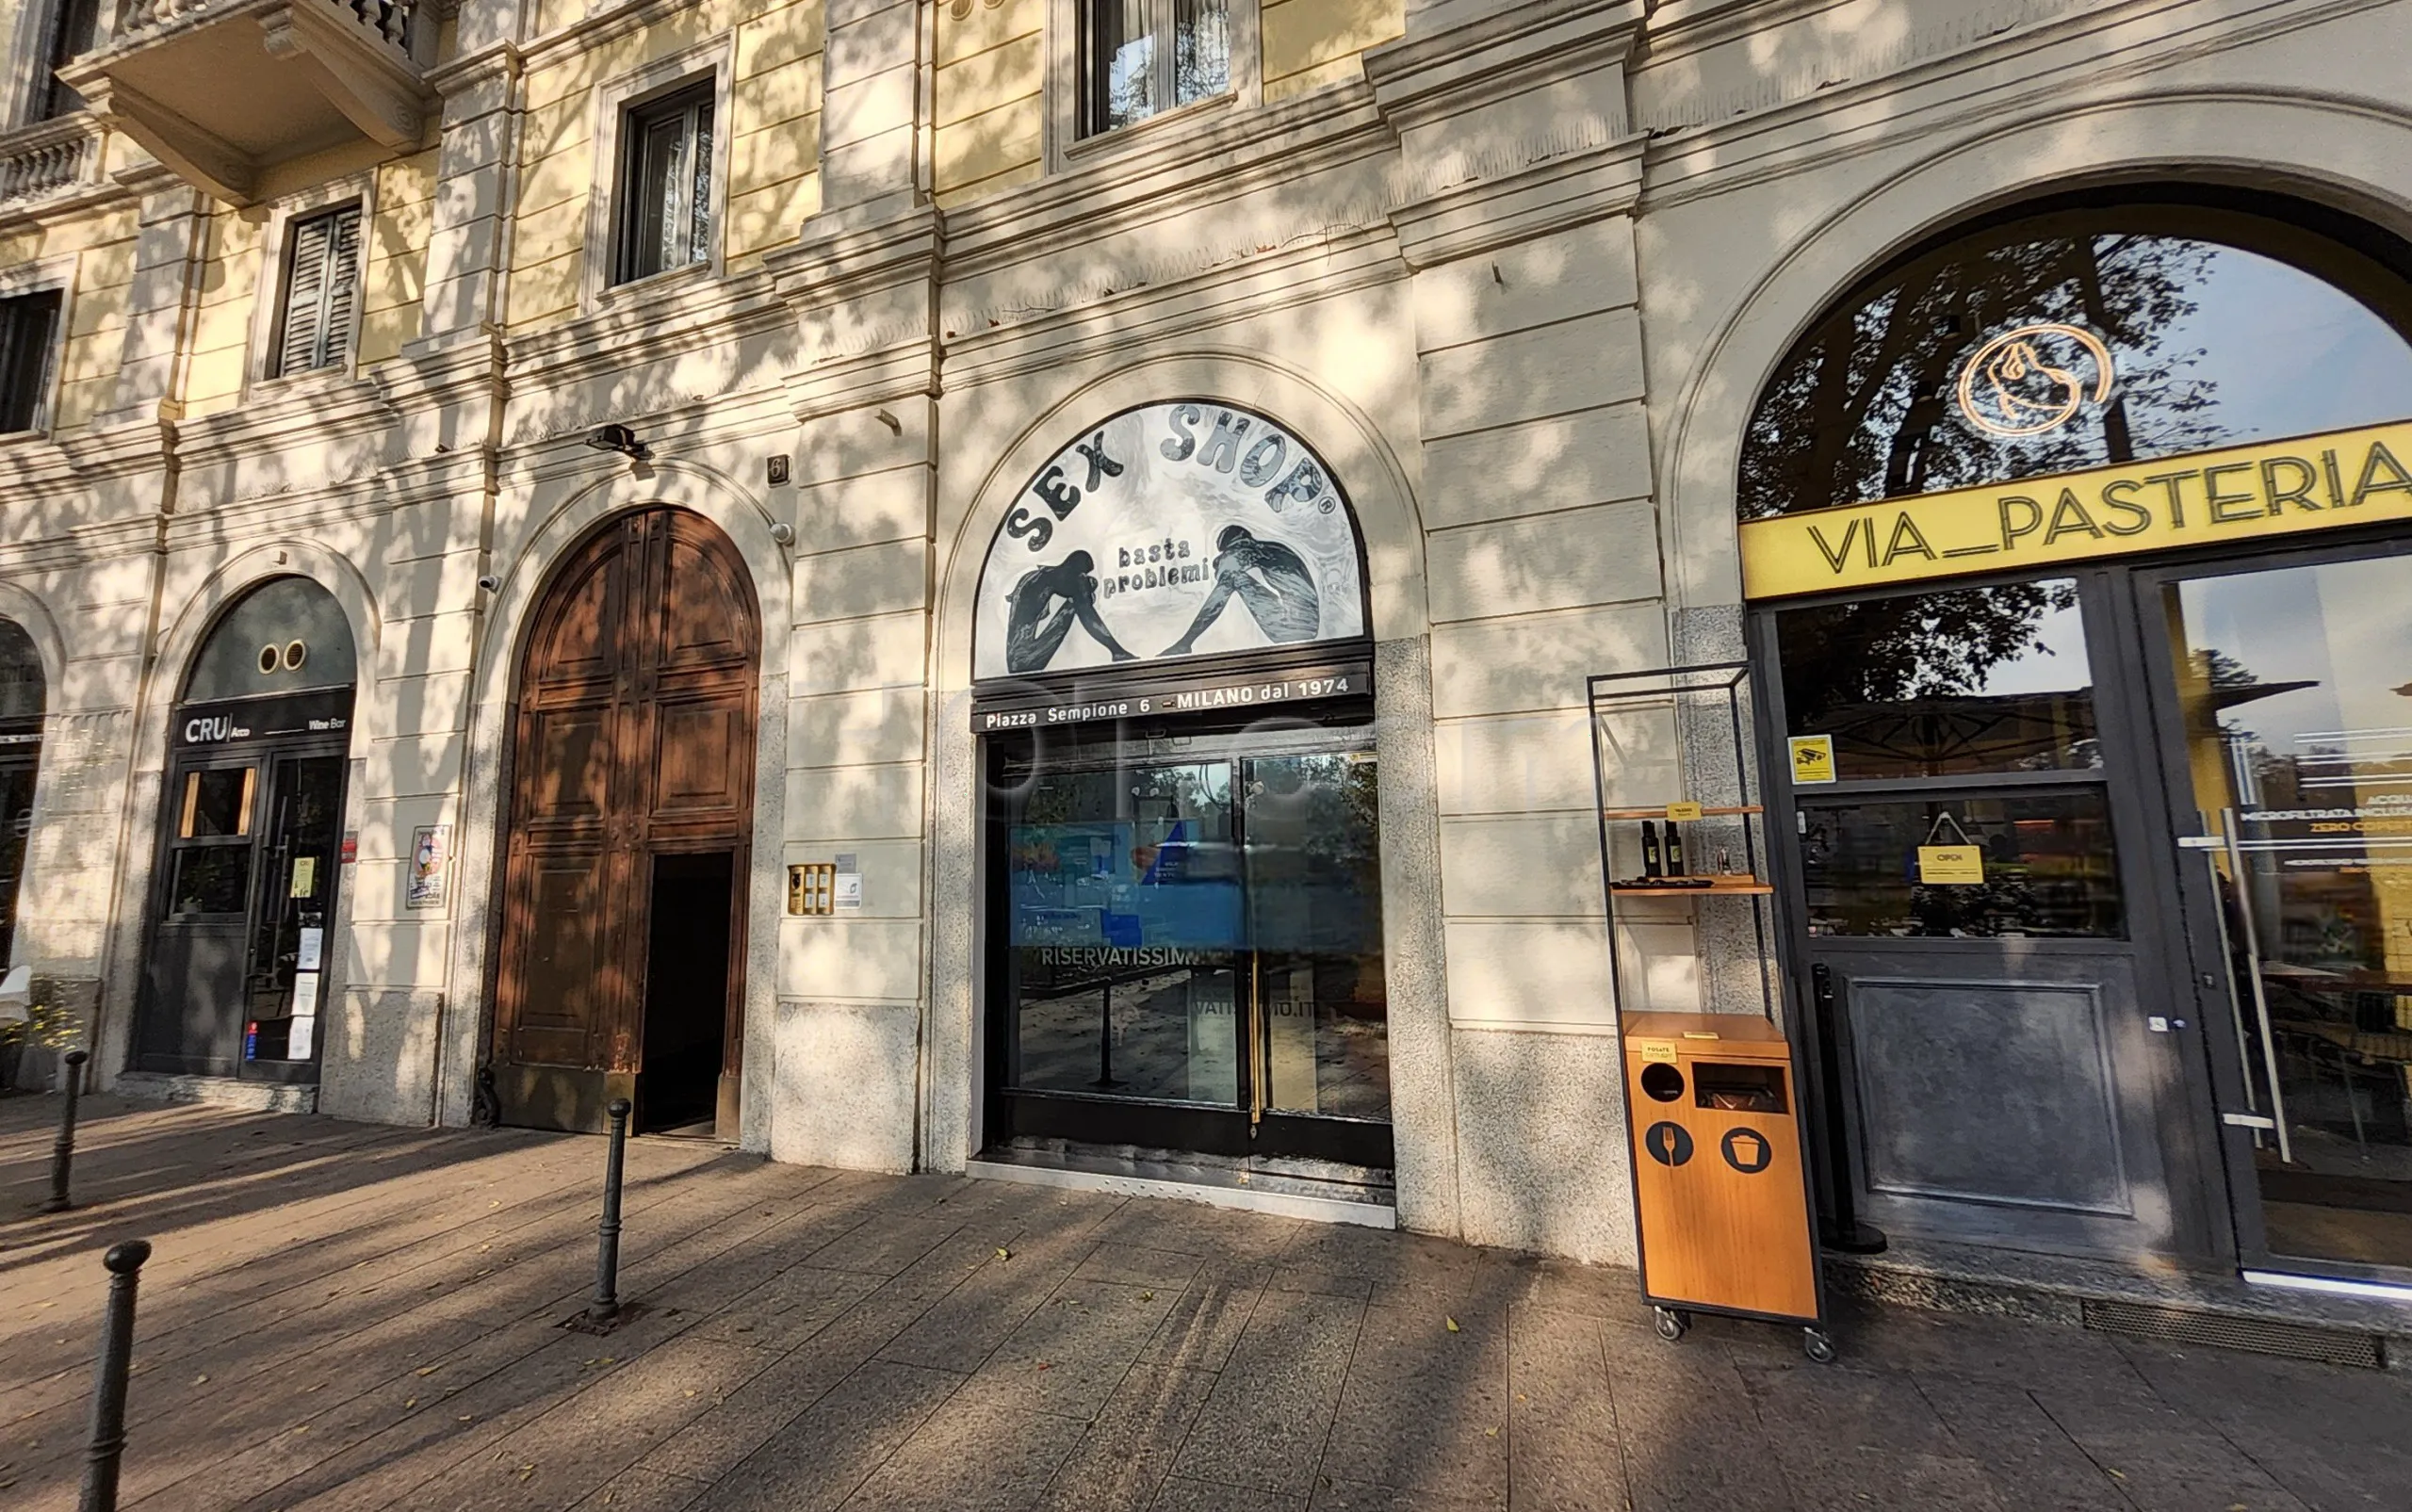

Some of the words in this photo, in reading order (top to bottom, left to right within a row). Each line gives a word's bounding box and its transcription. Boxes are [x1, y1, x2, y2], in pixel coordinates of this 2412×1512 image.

[769, 458, 781, 478] 6
[1007, 431, 1124, 552] SEX
[1118, 538, 1190, 568] basta
[1103, 557, 1209, 599] problemi
[986, 712, 1036, 728] Piazza
[1048, 702, 1128, 722] Sempione
[1140, 699, 1150, 712] 6
[1261, 685, 1289, 701] dal
[1298, 677, 1348, 696] 1974
[185, 716, 228, 742] CRU
[309, 720, 330, 731] Wine
[331, 718, 346, 729] Bar
